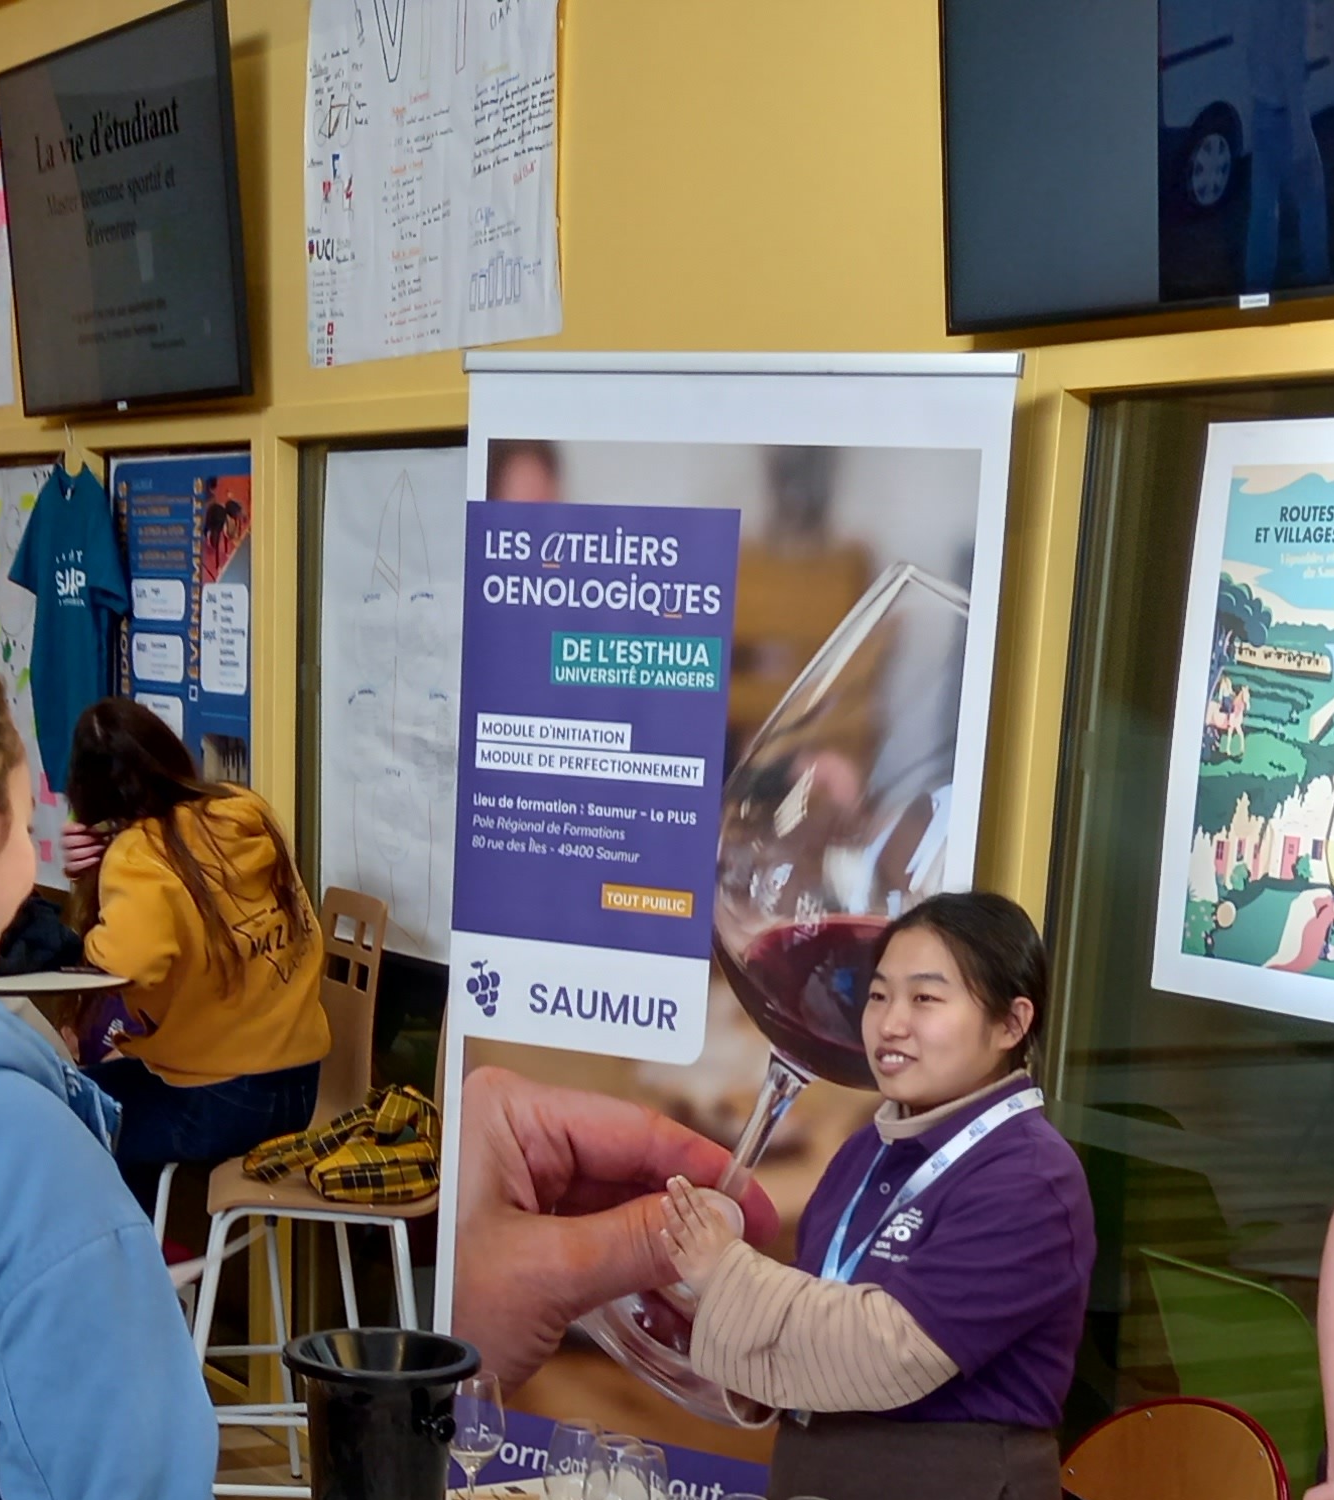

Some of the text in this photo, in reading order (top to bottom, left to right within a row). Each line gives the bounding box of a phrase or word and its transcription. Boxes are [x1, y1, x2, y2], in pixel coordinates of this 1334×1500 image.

[35, 97, 181, 174] La vie d'étudiant
[127, 161, 163, 205] sportif
[164, 164, 176, 187] et
[316, 238, 334, 261] UCI
[1279, 505, 1334, 522] ROUTES
[485, 530, 530, 561] LES
[1255, 527, 1270, 544] ET
[563, 638, 710, 667] DE L'ESTHUA
[640, 669, 715, 689] D'ANGERS
[481, 721, 625, 744] MODULE D'INITIATION
[480, 749, 700, 780] MODULE DE PERFECTIONNEMENT
[473, 792, 496, 808] Lieu
[498, 794, 514, 809] de
[516, 795, 577, 815] formation
[587, 803, 637, 820] Saumur
[650, 808, 665, 823] Le
[667, 810, 697, 826] PLUS
[497, 815, 545, 834] Régional
[547, 820, 561, 835] de
[563, 822, 626, 841] Formations
[471, 834, 486, 849] 80
[487, 838, 504, 851] rue
[506, 837, 526, 853] des
[557, 842, 594, 860] 49400
[595, 845, 641, 865] Saumur
[606, 892, 686, 913] TOUT PUBLIC
[529, 983, 678, 1031] SAUMUR
